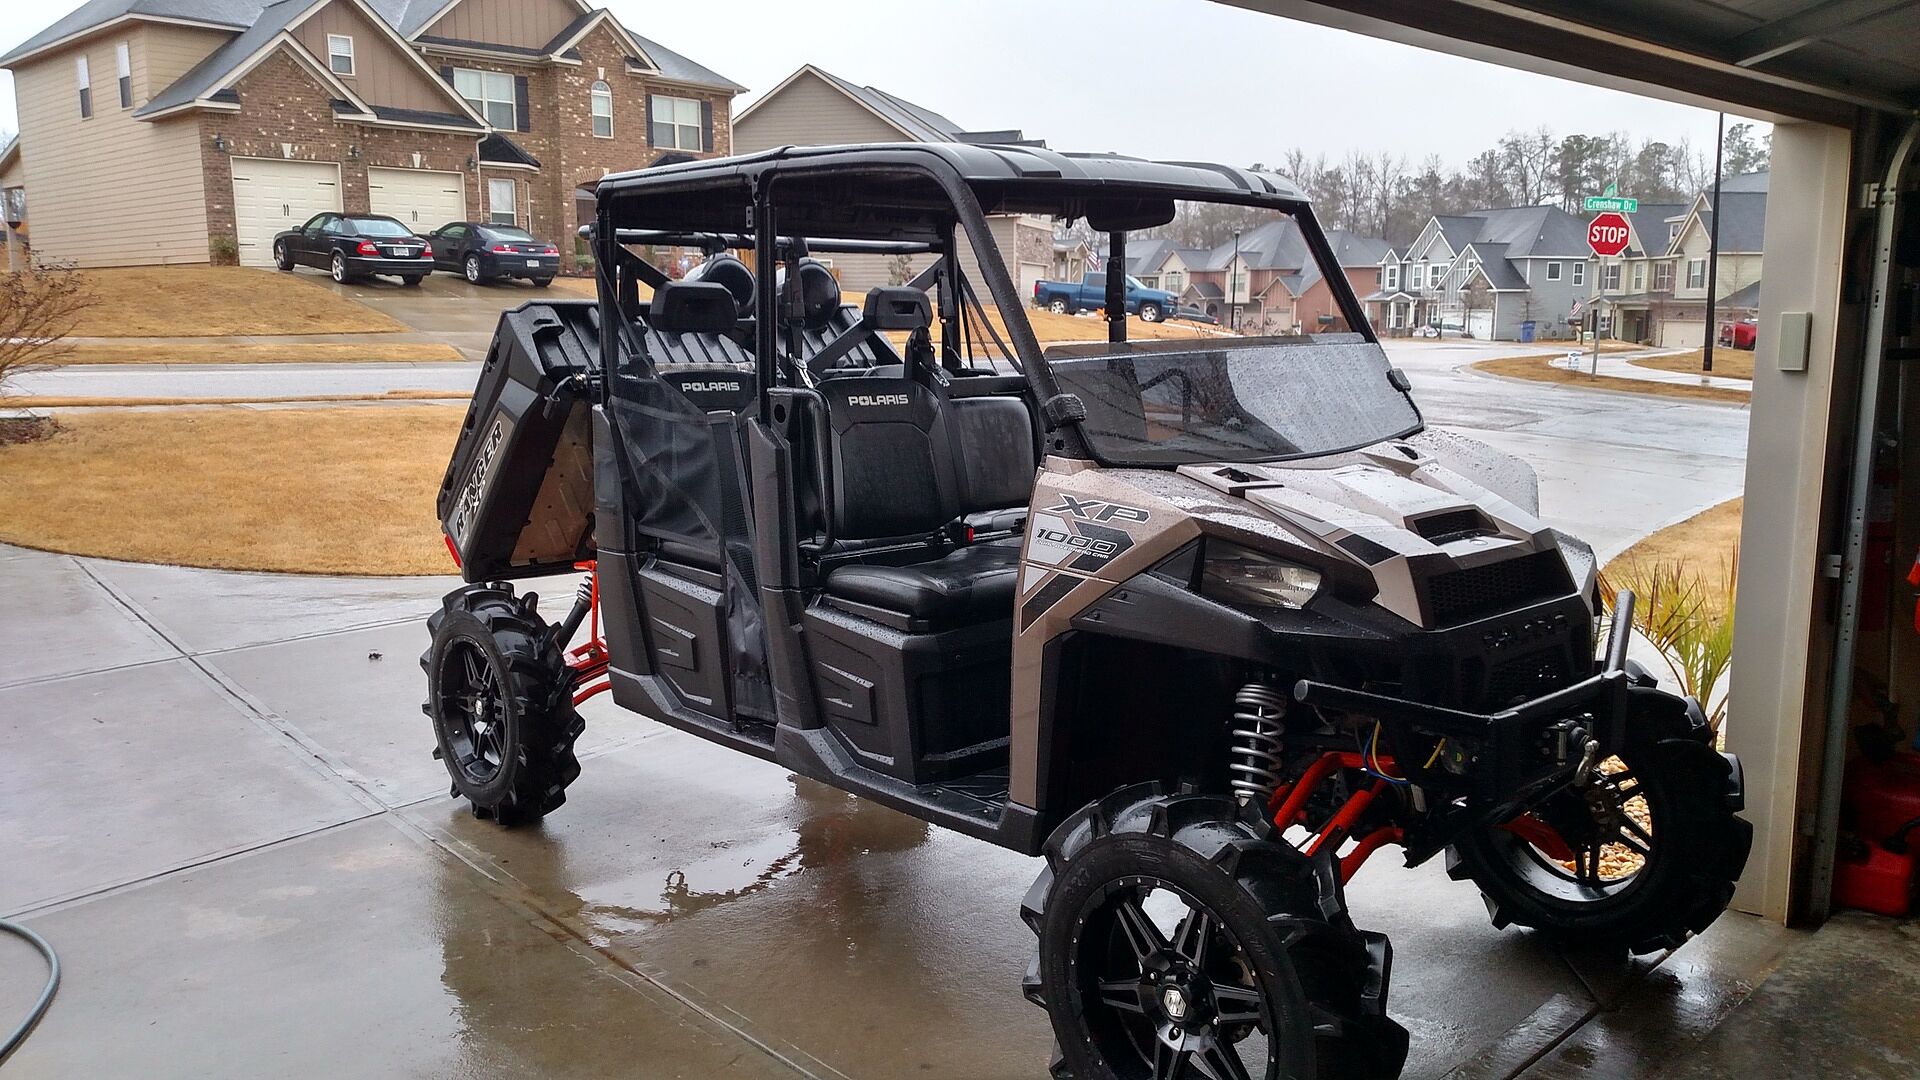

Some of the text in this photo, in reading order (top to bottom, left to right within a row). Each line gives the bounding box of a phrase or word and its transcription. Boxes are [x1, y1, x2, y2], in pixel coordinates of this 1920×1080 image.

[1587, 199, 1634, 211] Crenshaw Dr.
[1591, 226, 1627, 243] STOP
[681, 381, 740, 393] POLARIS
[847, 394, 909, 407] POLARIS
[456, 421, 503, 541] RANGER
[1040, 492, 1152, 525] XP
[1036, 527, 1118, 555] 1000
